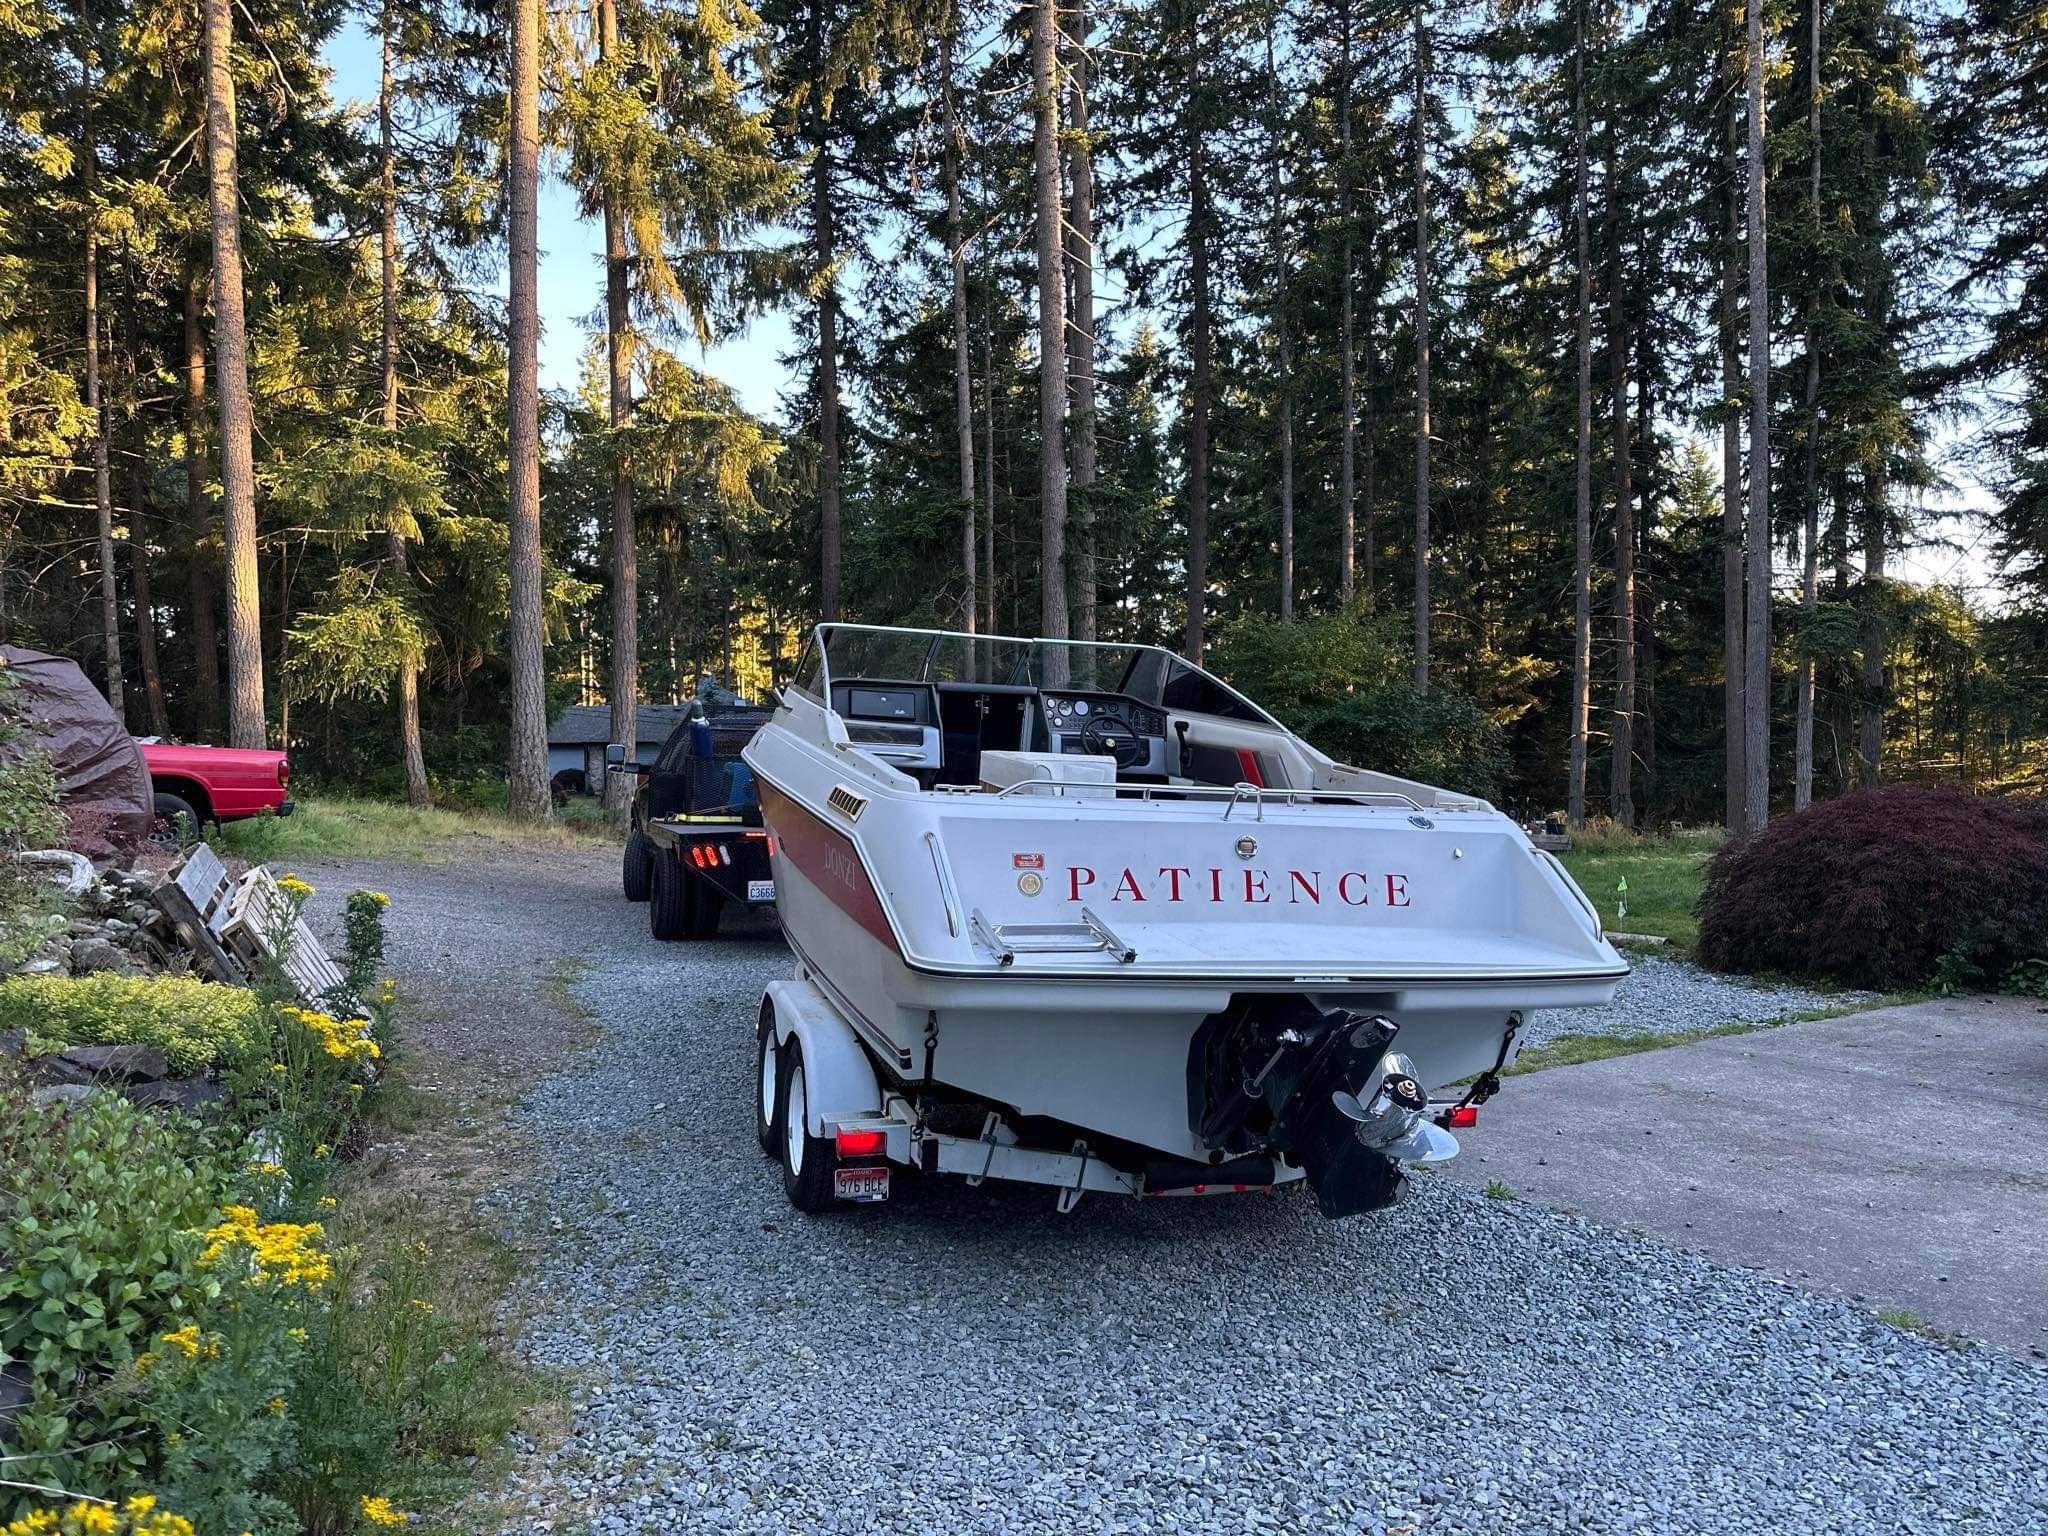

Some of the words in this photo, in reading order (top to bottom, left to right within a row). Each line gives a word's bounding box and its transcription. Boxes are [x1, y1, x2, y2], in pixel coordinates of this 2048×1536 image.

[823, 840, 856, 890] DONZI
[1066, 866, 1411, 907] PATIENCE
[840, 1178, 861, 1194] 976
